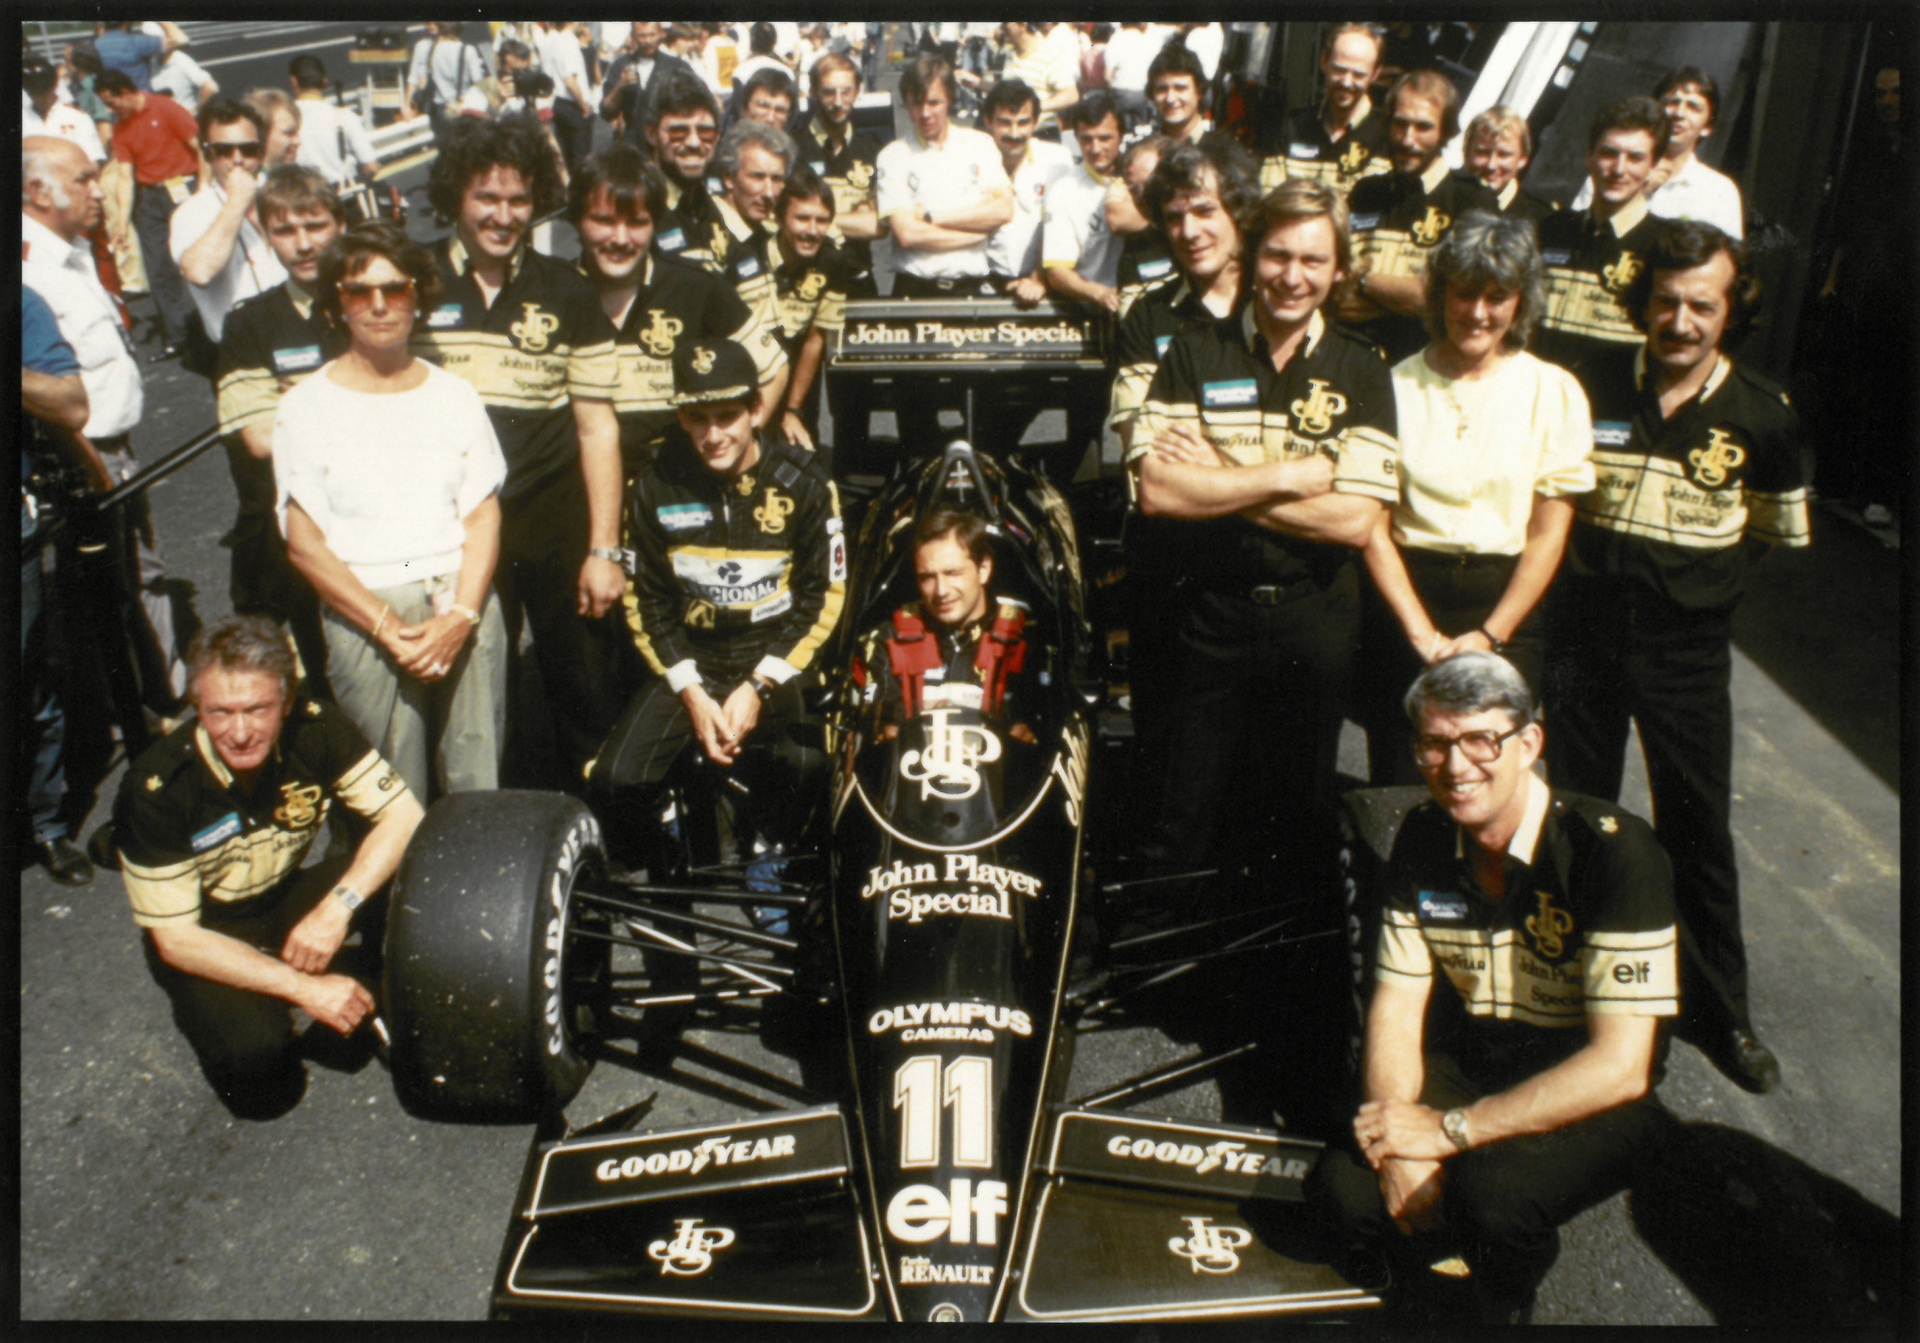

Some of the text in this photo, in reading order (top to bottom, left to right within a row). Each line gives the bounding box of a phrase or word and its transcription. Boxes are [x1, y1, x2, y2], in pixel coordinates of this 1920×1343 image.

[848, 322, 1090, 347] John Player Special
[862, 854, 1042, 898] John Player
[889, 886, 1012, 923] Special
[1612, 961, 1650, 984] elf
[869, 1002, 1033, 1036] OLYMPUS
[901, 1027, 995, 1042] CAMERAS
[893, 1054, 993, 1169] 11
[596, 1134, 796, 1181] GOODYEAR
[1107, 1135, 1309, 1180] GOODYEAR
[886, 1178, 1008, 1244] elf
[901, 1264, 994, 1284] RENAULT
